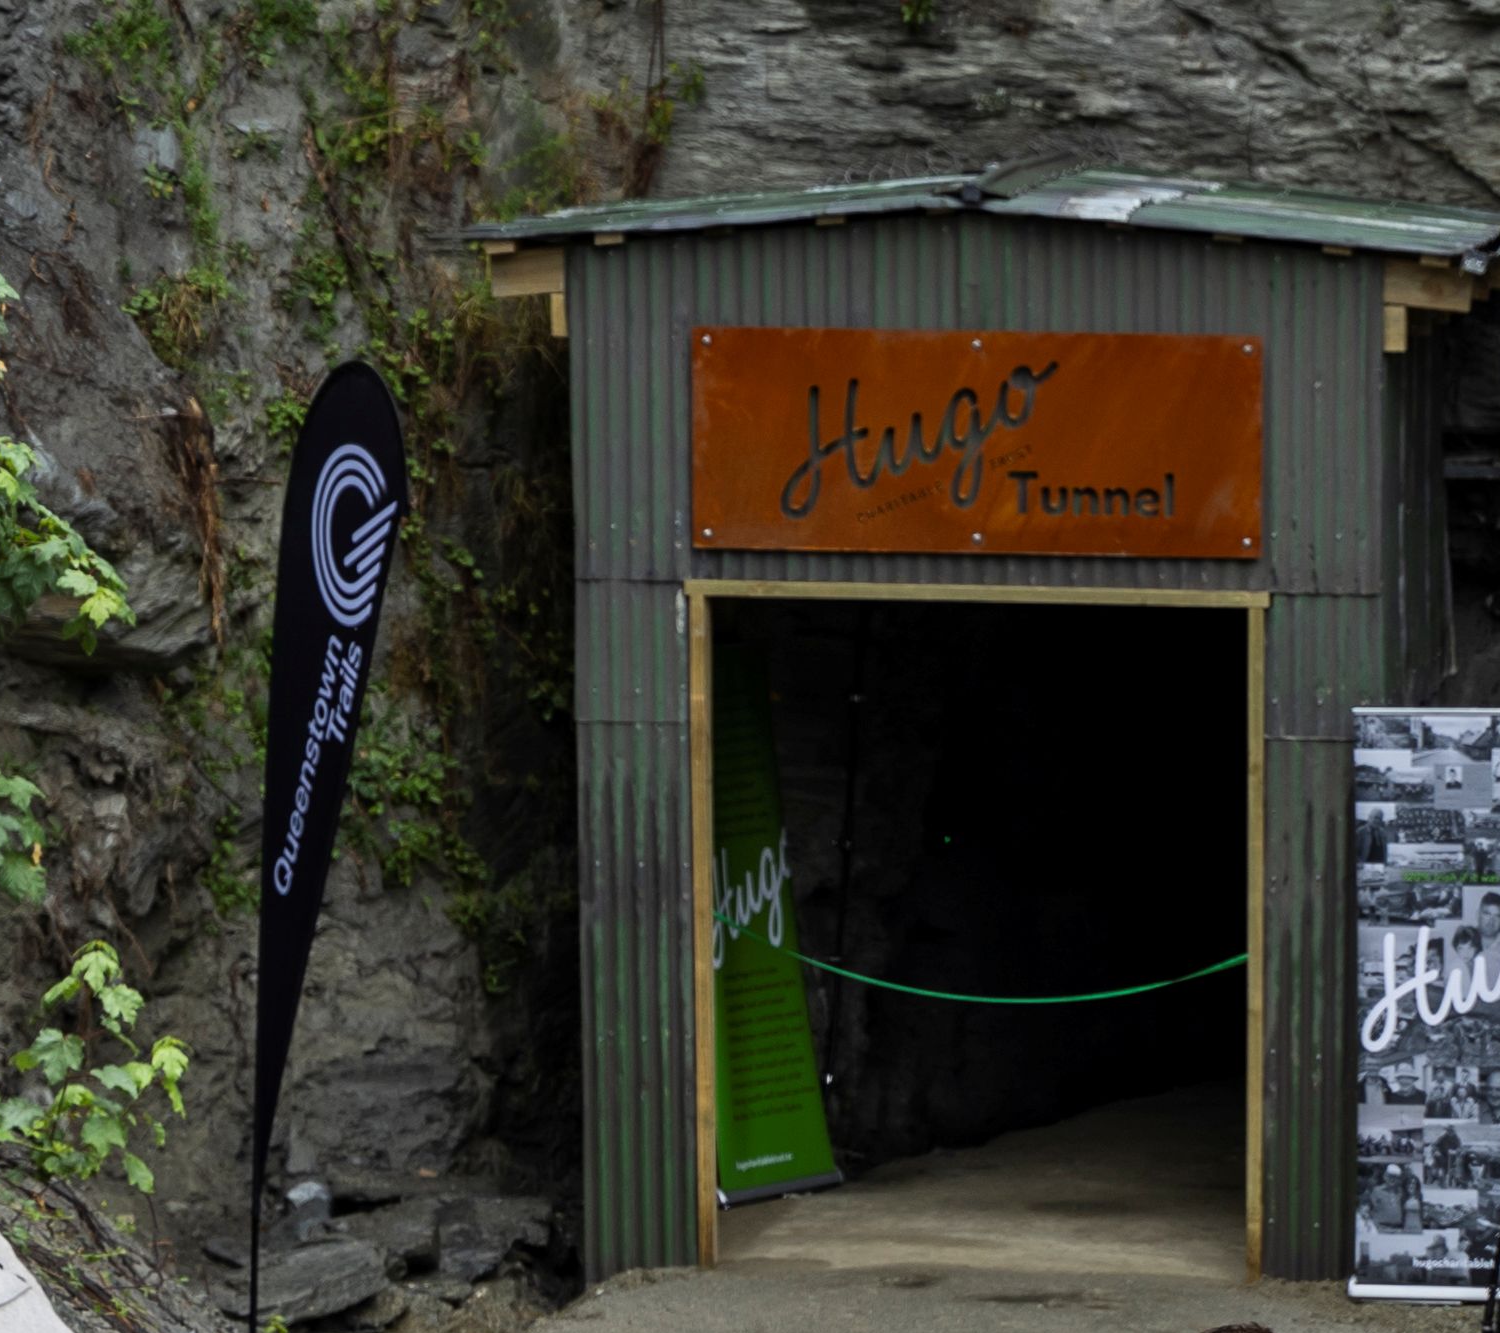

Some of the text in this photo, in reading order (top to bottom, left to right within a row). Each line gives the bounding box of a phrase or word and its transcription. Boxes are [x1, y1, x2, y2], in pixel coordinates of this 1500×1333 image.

[780, 361, 1059, 519] Hugo
[1007, 470, 1175, 517] Tunnel
[325, 641, 363, 744] Trails
[273, 634, 344, 896] Queenstown
